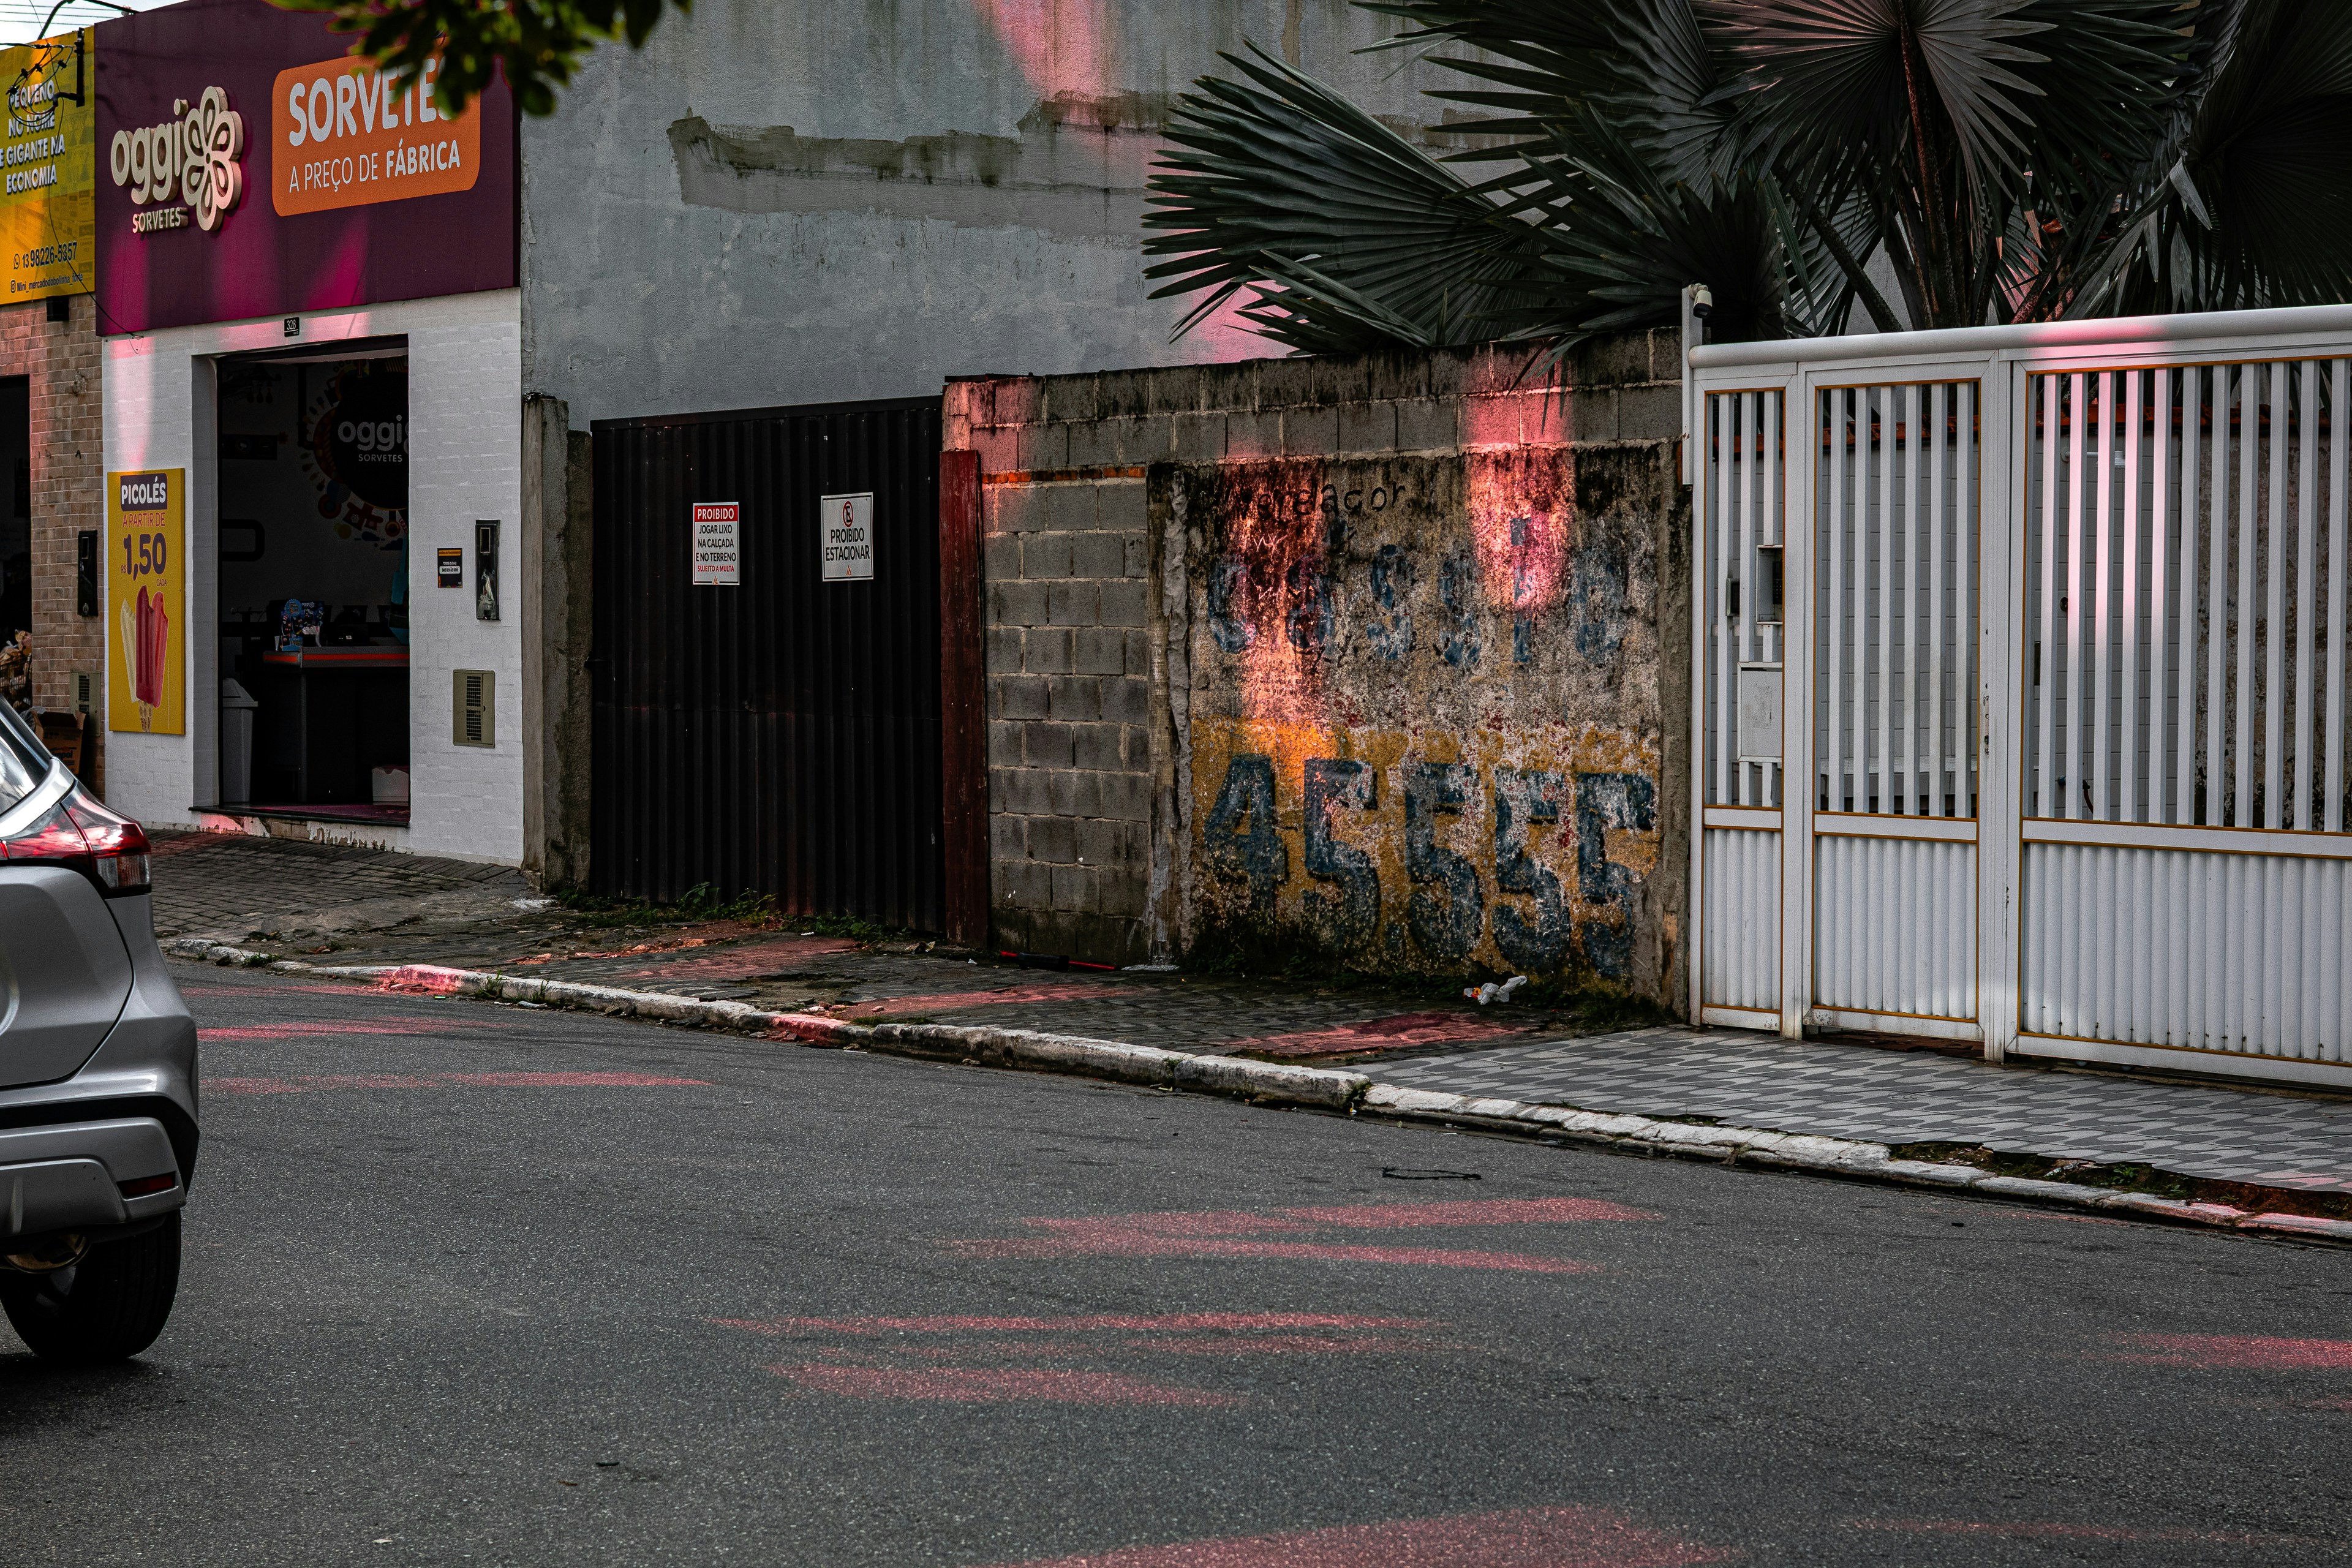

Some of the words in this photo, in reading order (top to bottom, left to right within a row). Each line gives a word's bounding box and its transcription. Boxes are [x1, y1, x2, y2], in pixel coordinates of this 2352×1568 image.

[10, 80, 55, 108] PEQUENO
[289, 58, 452, 147] SORVETE
[9, 116, 24, 137] NO
[26, 110, 55, 134] NOME
[7, 138, 48, 165] GIGANTE
[51, 134, 66, 155] NA
[111, 98, 184, 205] oggi
[7, 164, 57, 194] ECONOMIA
[289, 166, 300, 193] A
[304, 156, 353, 192] PREÇO
[360, 152, 378, 183] DE
[386, 138, 461, 178] FÁBRICA
[132, 206, 185, 233] SORVETES
[30, 241, 77, 268] 98226-5357
[286, 319, 296, 330] 328
[337, 414, 402, 451] oggi
[121, 476, 166, 504] PICOLÉS
[123, 513, 128, 527] A
[129, 513, 154, 527] PARTIR
[156, 512, 165, 526] DE
[698, 508, 734, 519] PROIBIDO
[699, 525, 718, 534] JOGAR
[719, 524, 733, 533] LIXO
[831, 527, 864, 543] PROIBIDO
[124, 532, 167, 581] 1,50
[696, 552, 699, 562] E
[700, 552, 709, 562] NO
[710, 552, 736, 562] TERRENO
[698, 538, 706, 548] NA
[707, 538, 734, 549] CALÇADA
[826, 545, 870, 562] ESTACIONAR
